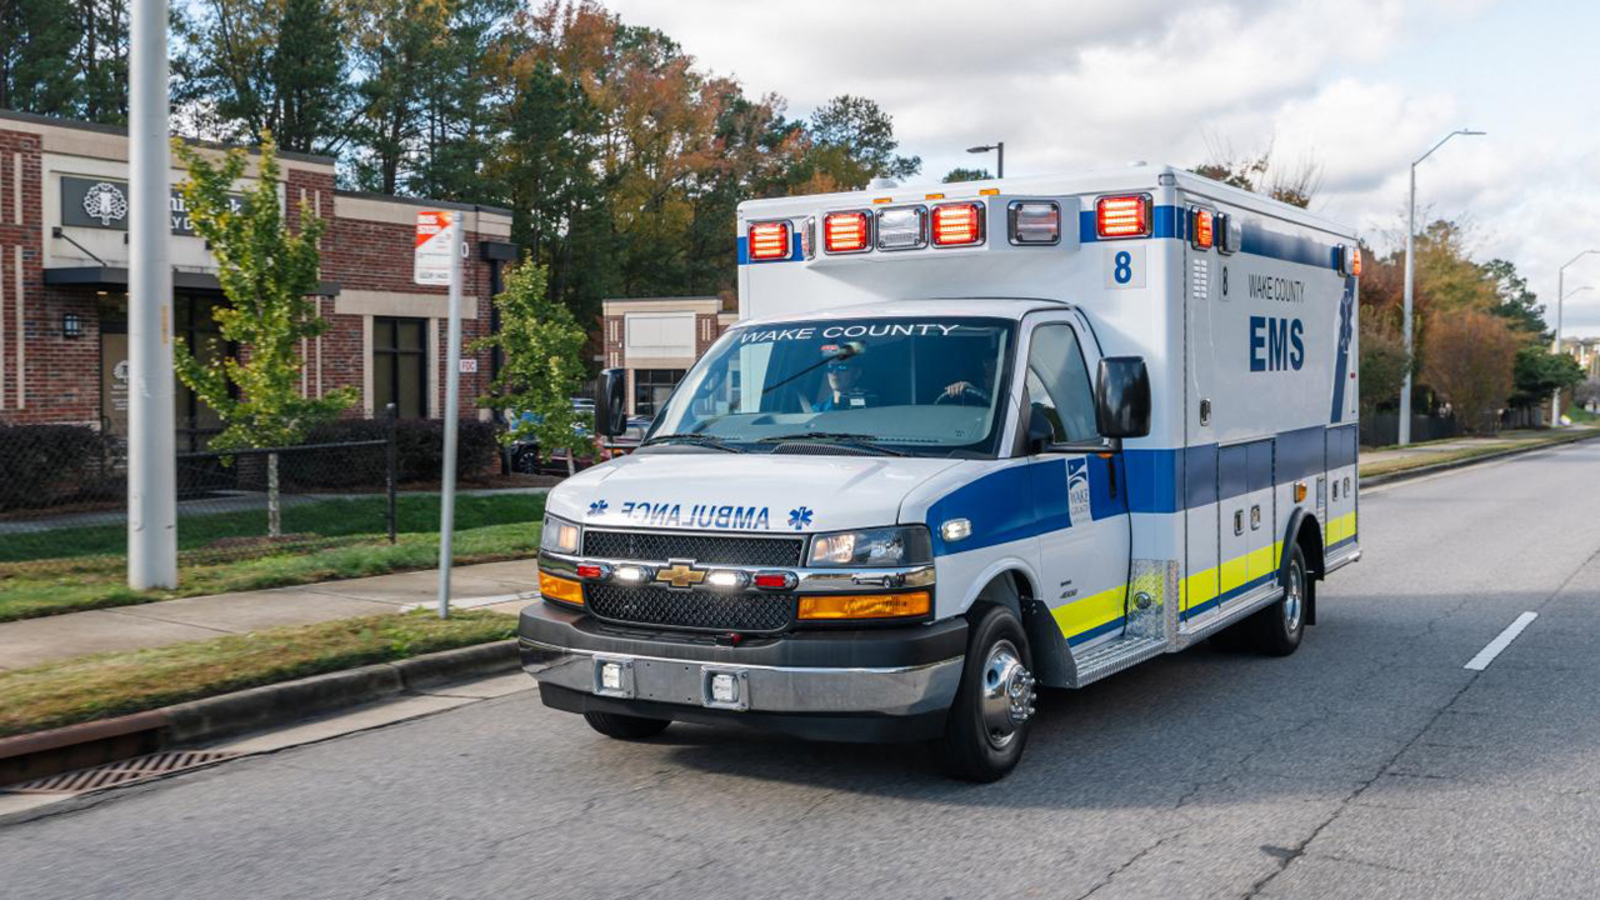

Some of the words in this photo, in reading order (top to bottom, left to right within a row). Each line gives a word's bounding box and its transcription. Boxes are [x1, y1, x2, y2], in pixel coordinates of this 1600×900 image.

[1114, 251, 1132, 284] 8
[1222, 266, 1229, 297] 8
[1249, 274, 1273, 300] WAKE
[1274, 279, 1305, 302] COUNTY
[741, 327, 817, 344] WAKE
[822, 325, 959, 339] COUNTY
[1250, 316, 1305, 372] EMS
